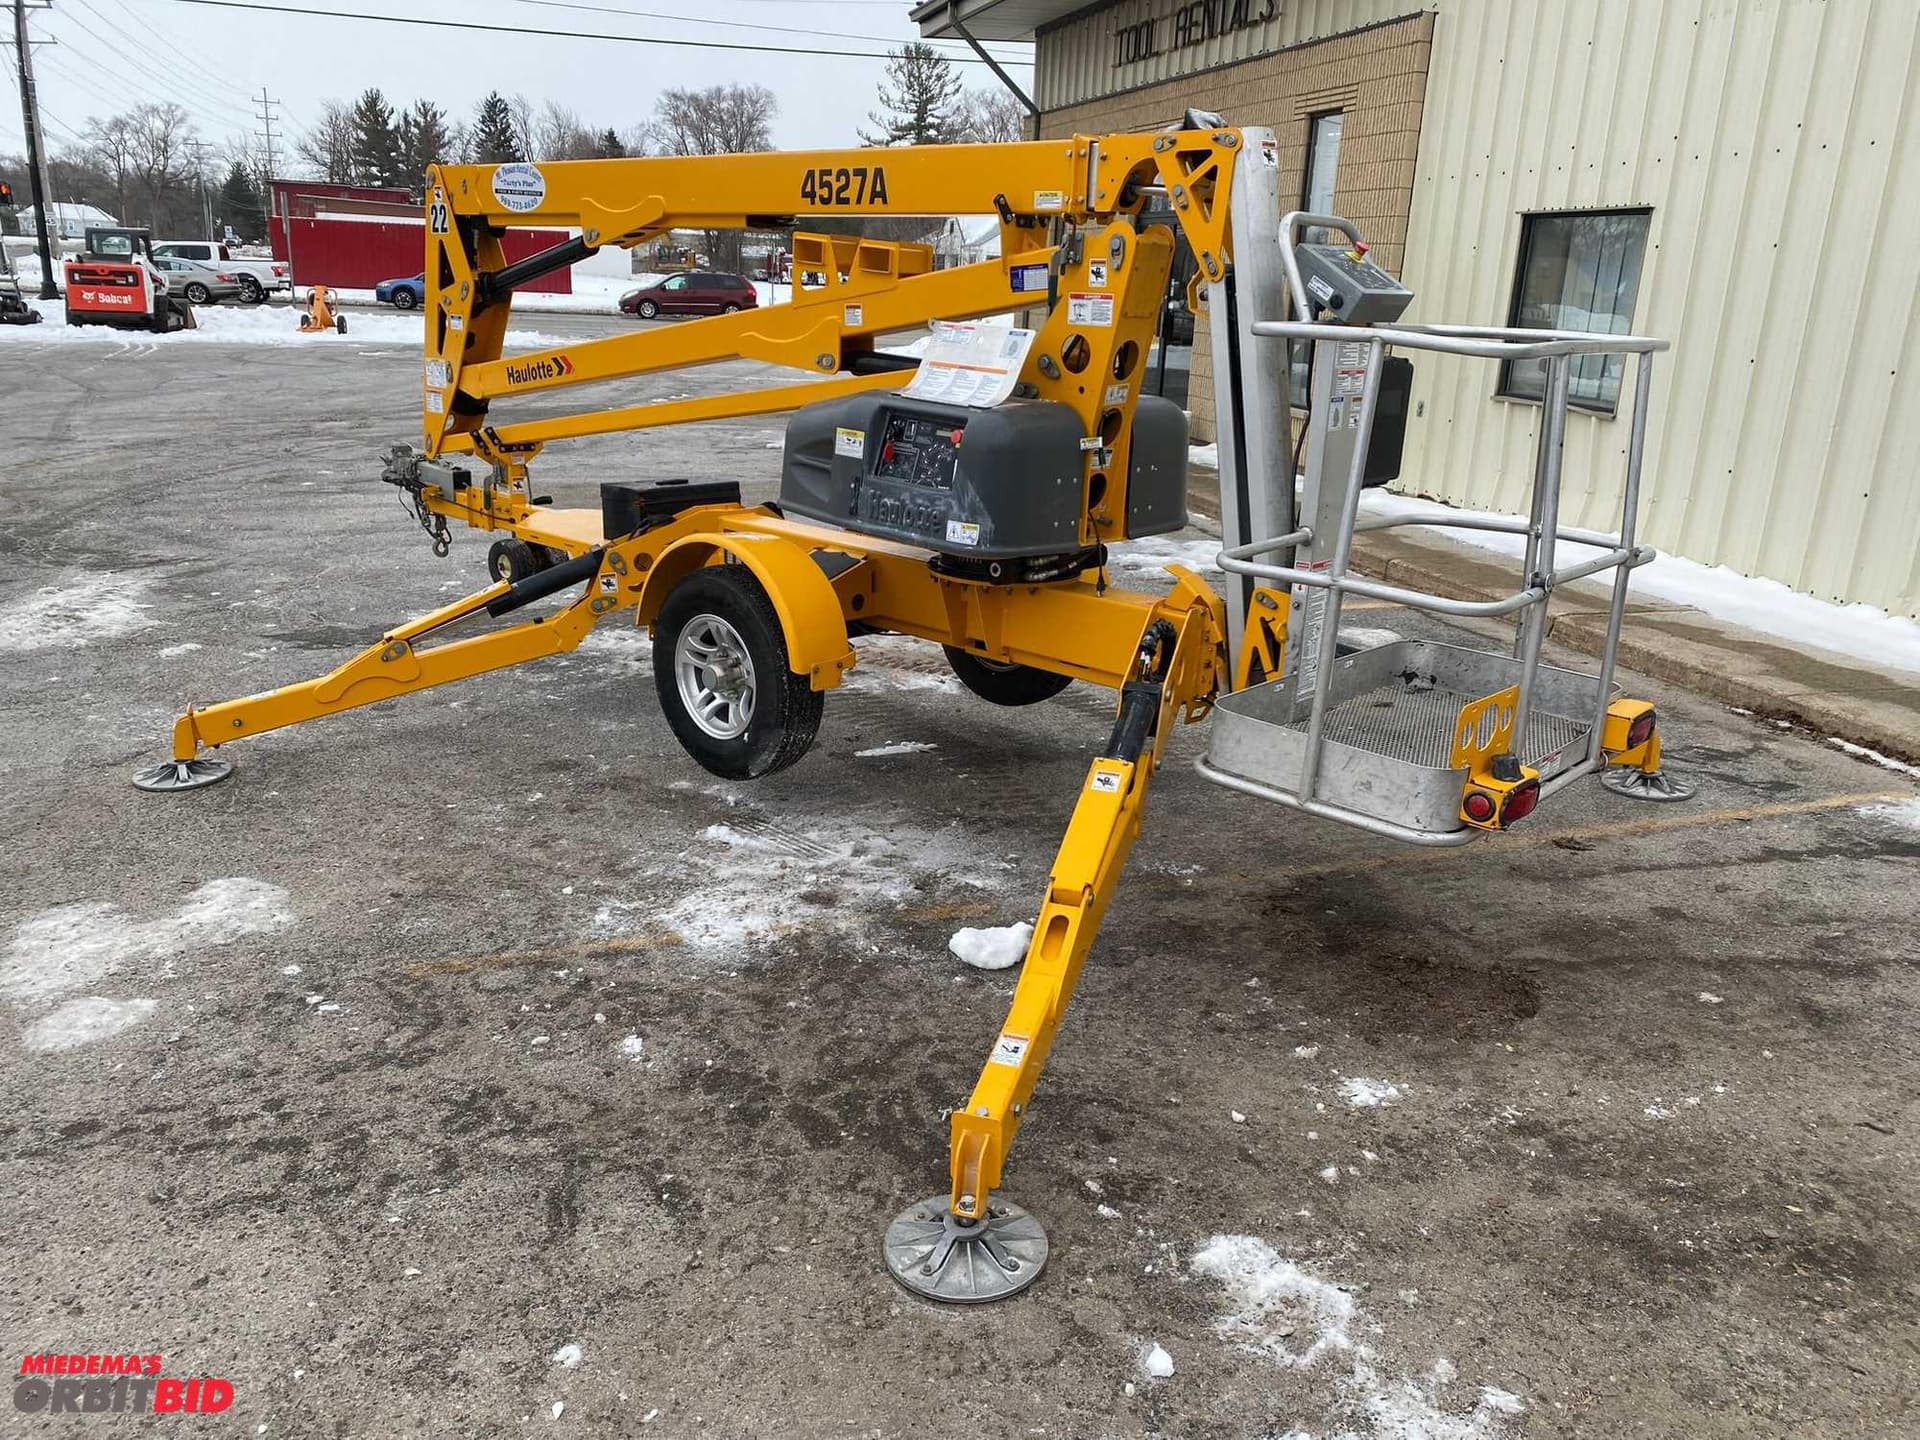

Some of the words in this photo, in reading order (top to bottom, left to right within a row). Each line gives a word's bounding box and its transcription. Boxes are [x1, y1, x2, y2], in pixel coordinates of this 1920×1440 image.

[1113, 18, 1164, 67] TOOL
[1174, 0, 1276, 49] RENTALS
[801, 167, 888, 206] 4527A
[430, 203, 448, 233] 22
[98, 292, 132, 305] Bobcat
[506, 361, 554, 385] Haulotte
